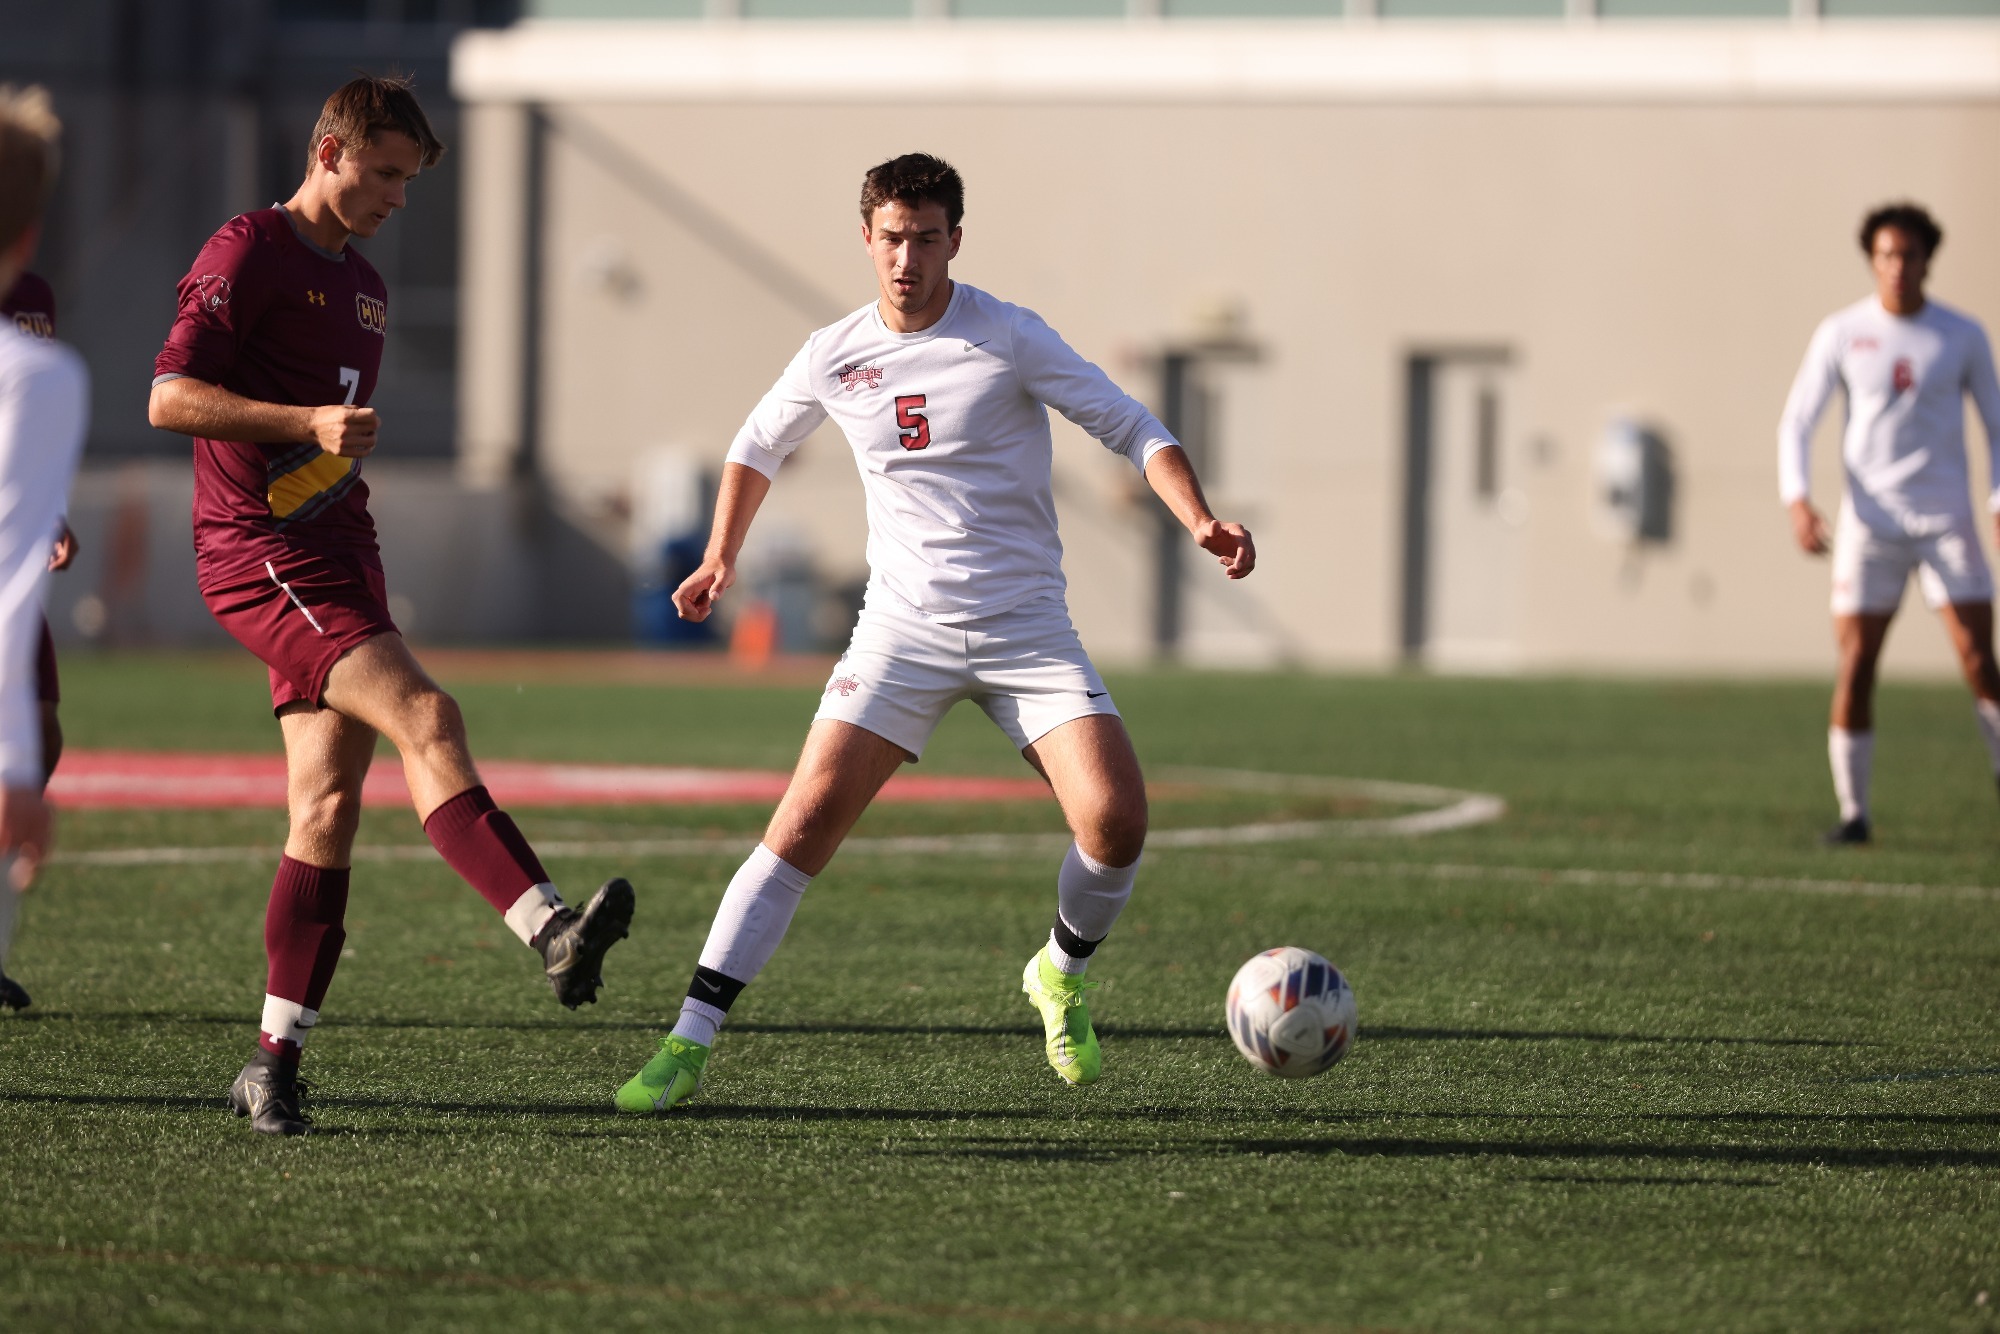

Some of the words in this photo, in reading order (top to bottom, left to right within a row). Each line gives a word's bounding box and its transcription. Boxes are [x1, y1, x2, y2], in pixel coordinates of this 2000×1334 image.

[339, 366, 360, 406] 7
[839, 368, 884, 384] RAIDERS
[895, 394, 931, 451] 5
